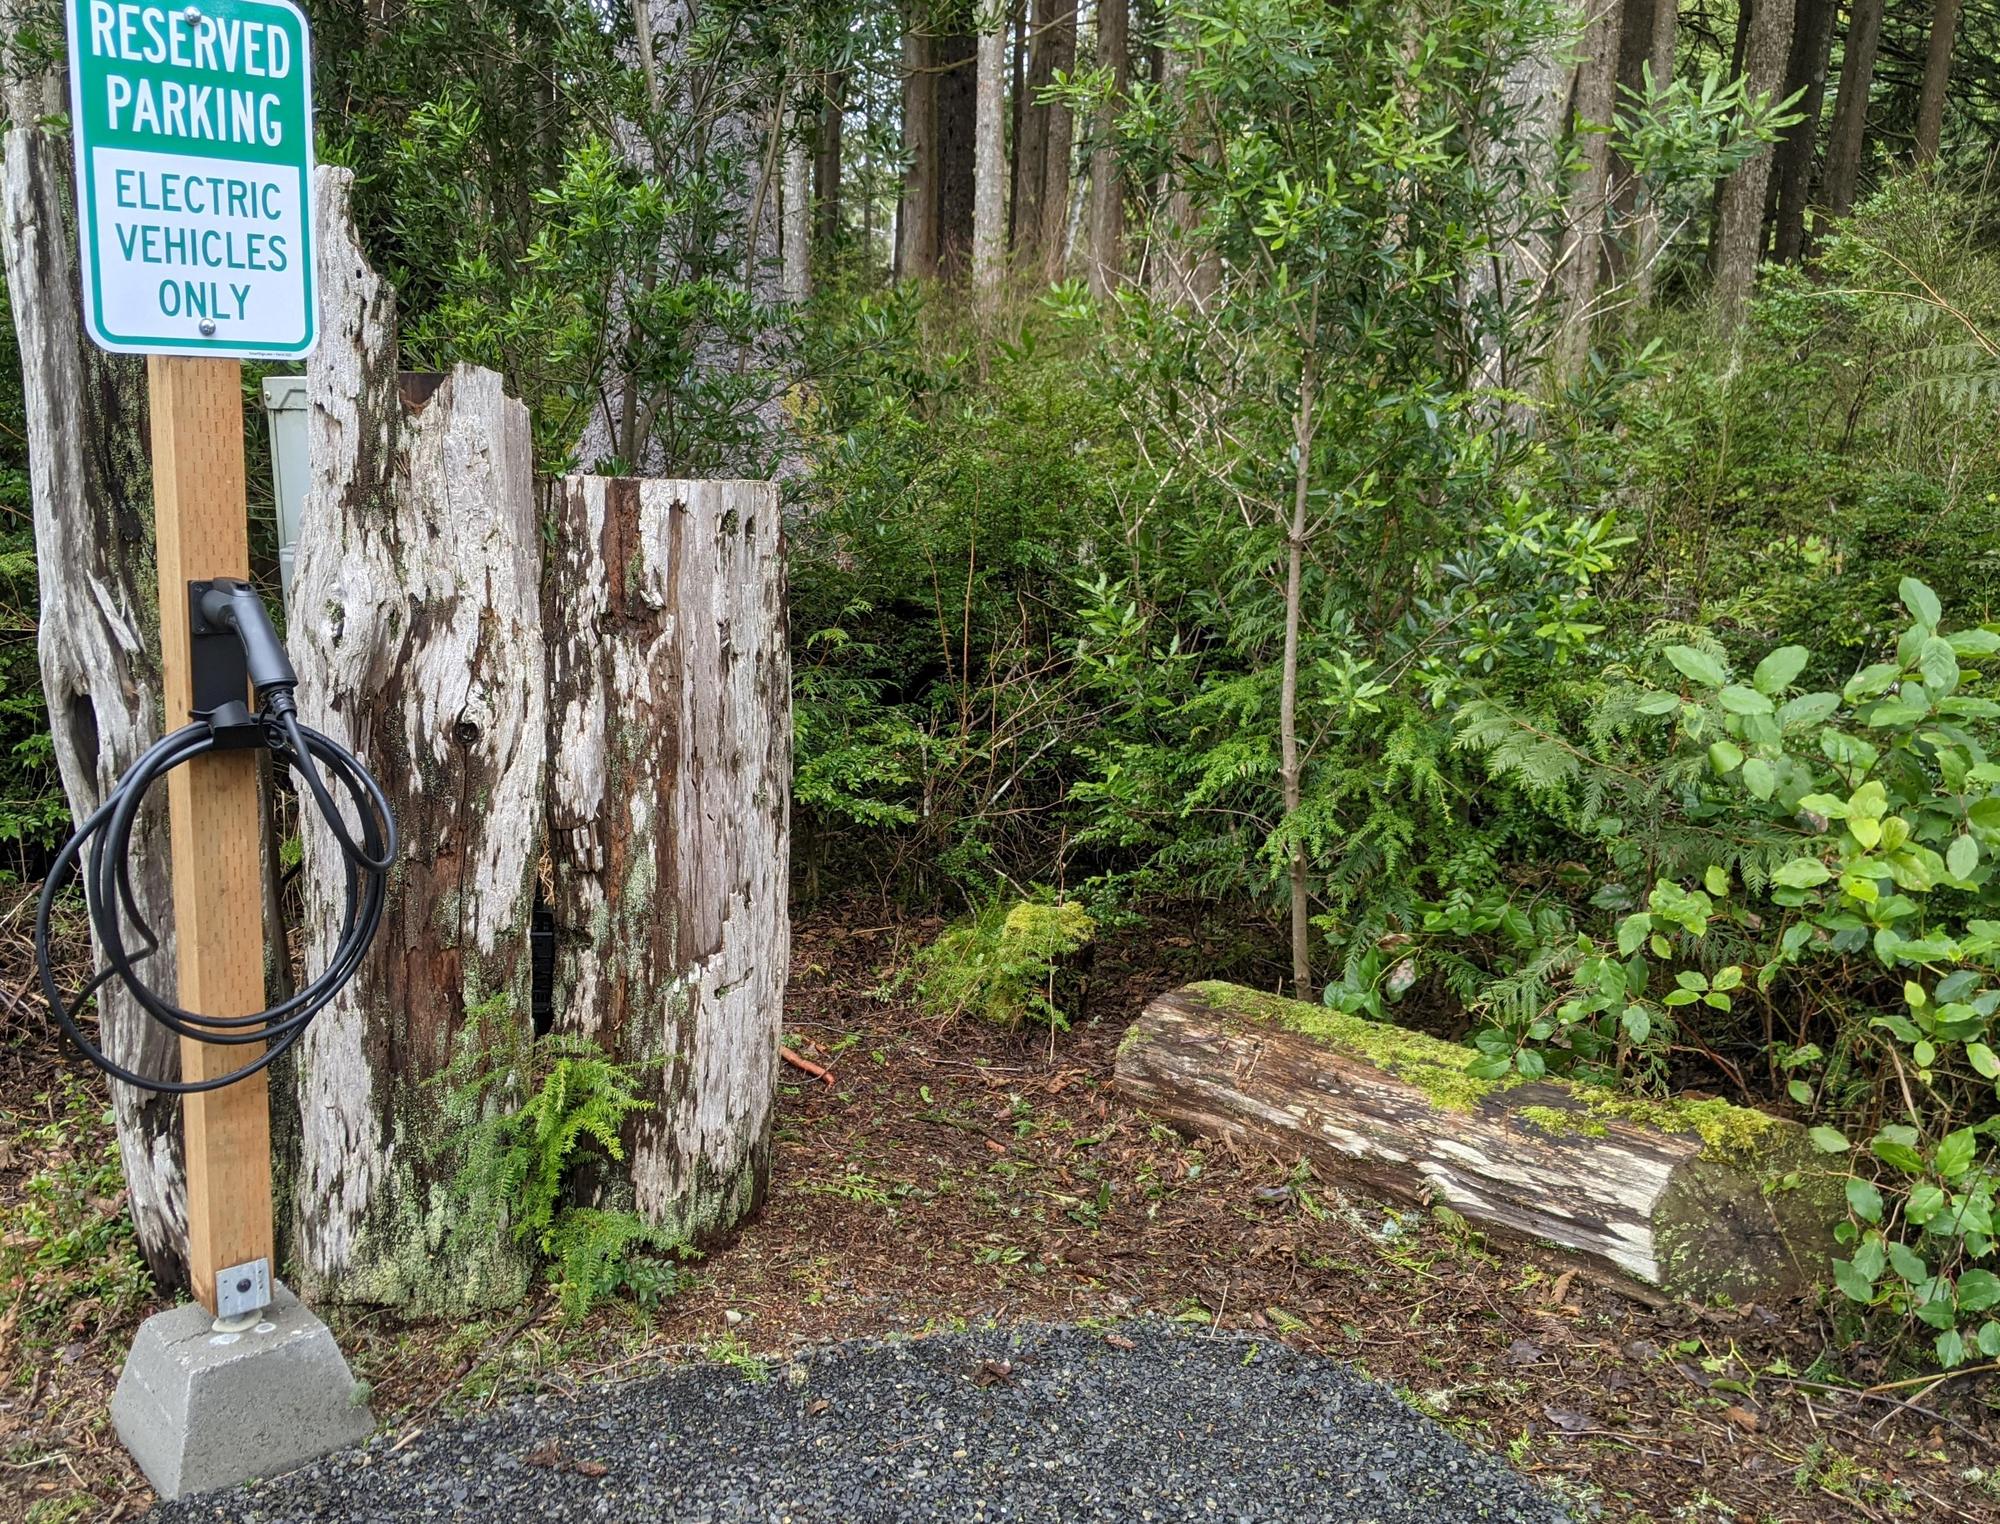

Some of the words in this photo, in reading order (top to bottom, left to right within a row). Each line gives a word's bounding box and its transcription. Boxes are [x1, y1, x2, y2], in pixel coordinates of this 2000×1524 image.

[90, 0, 290, 79] RESERVED
[106, 74, 283, 147] PARKING
[115, 168, 282, 220] ELECTRIC
[115, 223, 288, 272] VEHICLES
[159, 279, 251, 320] ONLY
